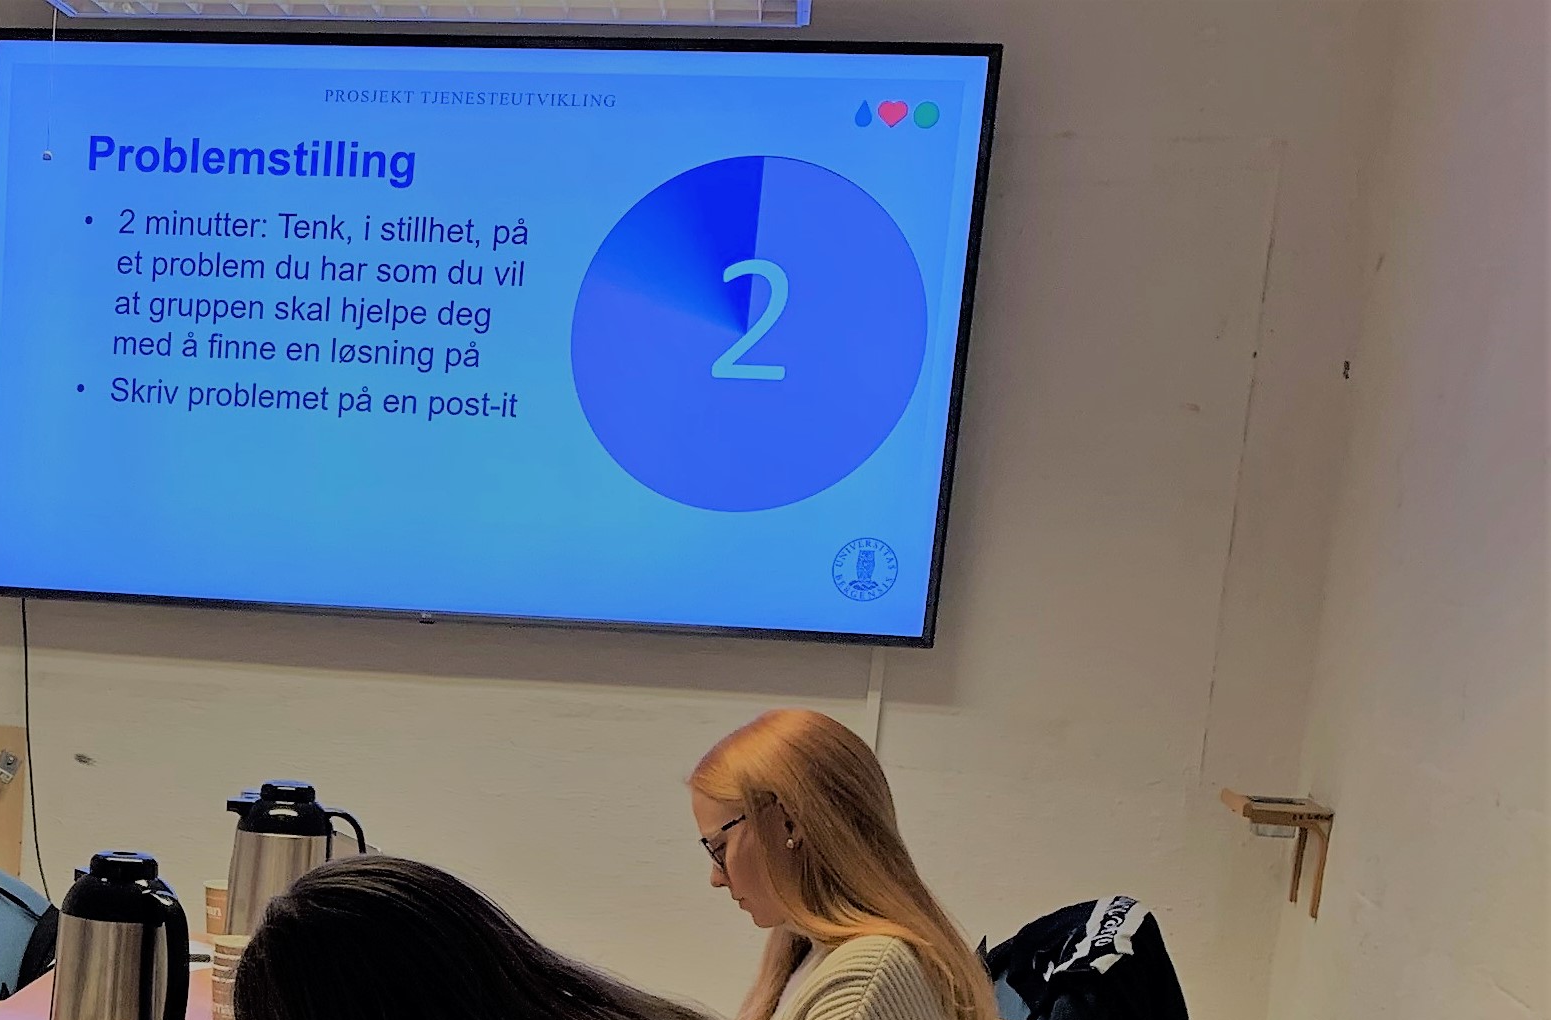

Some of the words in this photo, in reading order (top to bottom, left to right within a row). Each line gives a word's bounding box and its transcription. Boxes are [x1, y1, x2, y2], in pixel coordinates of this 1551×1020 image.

[324, 89, 415, 104] PROSJEKT
[420, 90, 616, 108] TJENESTEUTVIKLING
[88, 135, 416, 189] Problemstilling
[118, 208, 136, 235] 2
[145, 209, 268, 239] minutter:
[277, 212, 352, 246] Tenk,
[364, 214, 371, 242] i
[380, 215, 480, 249] stillhet,
[492, 217, 529, 252] på
[116, 250, 143, 275] et
[151, 251, 265, 283] problem
[275, 253, 310, 281] du
[320, 254, 369, 283] har
[376, 263, 437, 285] som
[447, 258, 483, 286] du
[494, 260, 525, 287] vil
[114, 290, 141, 316] at
[149, 297, 264, 326] gruppen
[274, 295, 331, 322] skal
[341, 296, 427, 331] hjelpe
[437, 299, 492, 335] deg
[711, 258, 790, 381] 2
[113, 331, 172, 357] med
[181, 331, 198, 358] å
[207, 332, 276, 361] finne
[285, 342, 320, 363] en
[330, 337, 435, 374] løsning
[444, 340, 480, 374] på
[110, 376, 179, 405] Skriv
[187, 381, 330, 412] problemet
[337, 385, 372, 419] på
[382, 394, 417, 415] en
[427, 391, 519, 422] post-it
[835, 540, 896, 569] UNIVERSITAS
